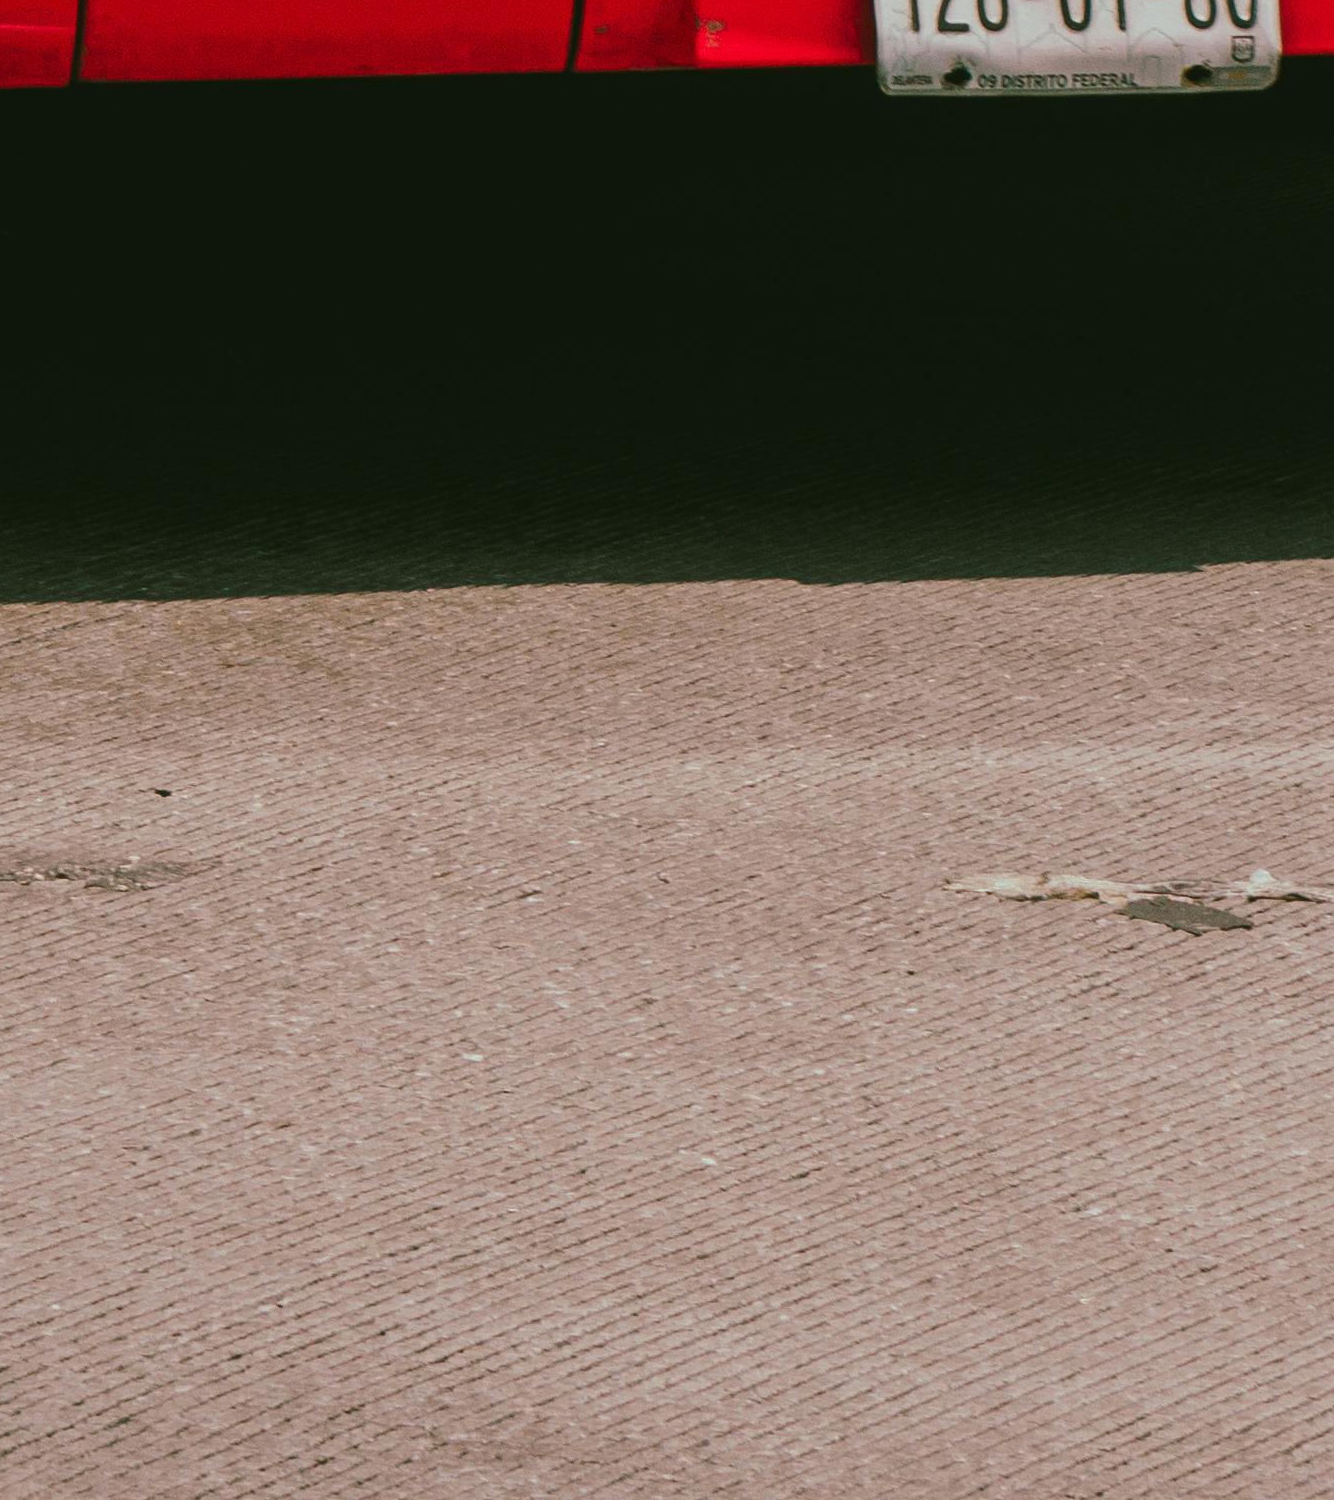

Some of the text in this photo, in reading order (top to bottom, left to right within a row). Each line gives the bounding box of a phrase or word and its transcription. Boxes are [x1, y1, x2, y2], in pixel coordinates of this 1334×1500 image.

[977, 72, 1140, 89] 09 DISTRITO FEDERAL
